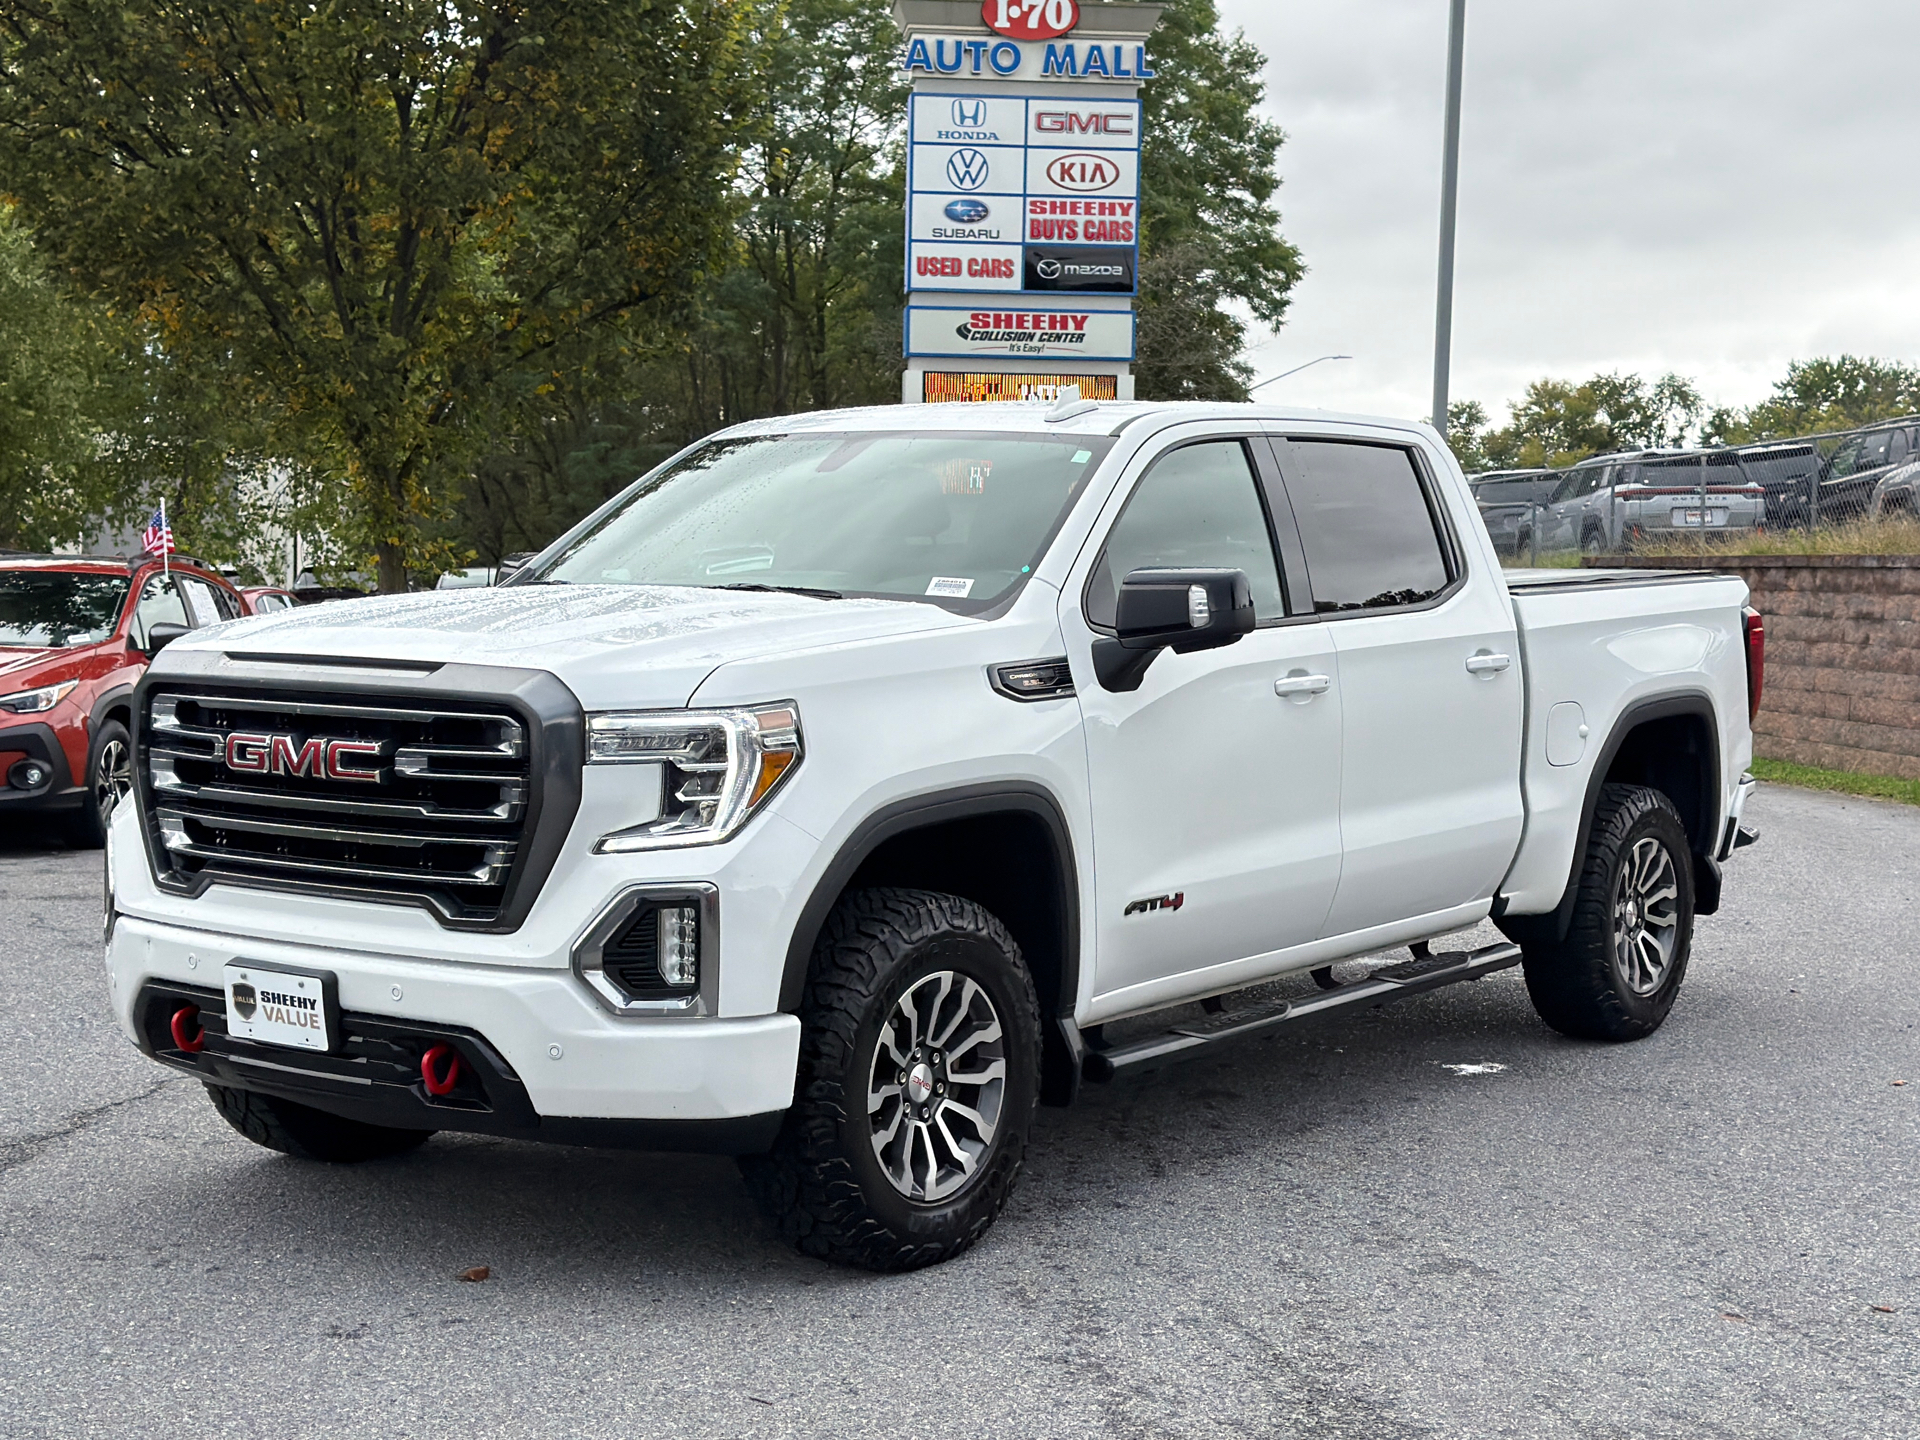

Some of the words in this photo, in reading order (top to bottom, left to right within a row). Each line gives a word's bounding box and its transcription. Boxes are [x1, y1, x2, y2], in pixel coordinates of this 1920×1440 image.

[903, 38, 1022, 75] AUTO
[1041, 43, 1155, 78] MALL
[1035, 110, 1134, 135] GMC
[937, 130, 1000, 141] HONDA
[1059, 162, 1108, 183] KIA
[1029, 200, 1134, 217] SHEEHY
[931, 228, 1000, 239] SUBARU
[1029, 218, 1078, 241] BUYS
[1083, 220, 1134, 242] CARS
[916, 256, 962, 277] USED
[967, 257, 1015, 279] CARS
[1064, 264, 1123, 276] mazda
[970, 313, 1089, 331] SHEEHY
[970, 330, 1036, 342] COLLISION
[1038, 332, 1086, 343] CENTER
[1008, 343, 1021, 353] It's
[1022, 344, 1046, 354] Easy!
[225, 732, 382, 784] GMC
[1124, 891, 1184, 916] AT4
[233, 995, 256, 1005] VALUE
[260, 990, 318, 1011] SHEEHY
[262, 1004, 321, 1030] VALUE
